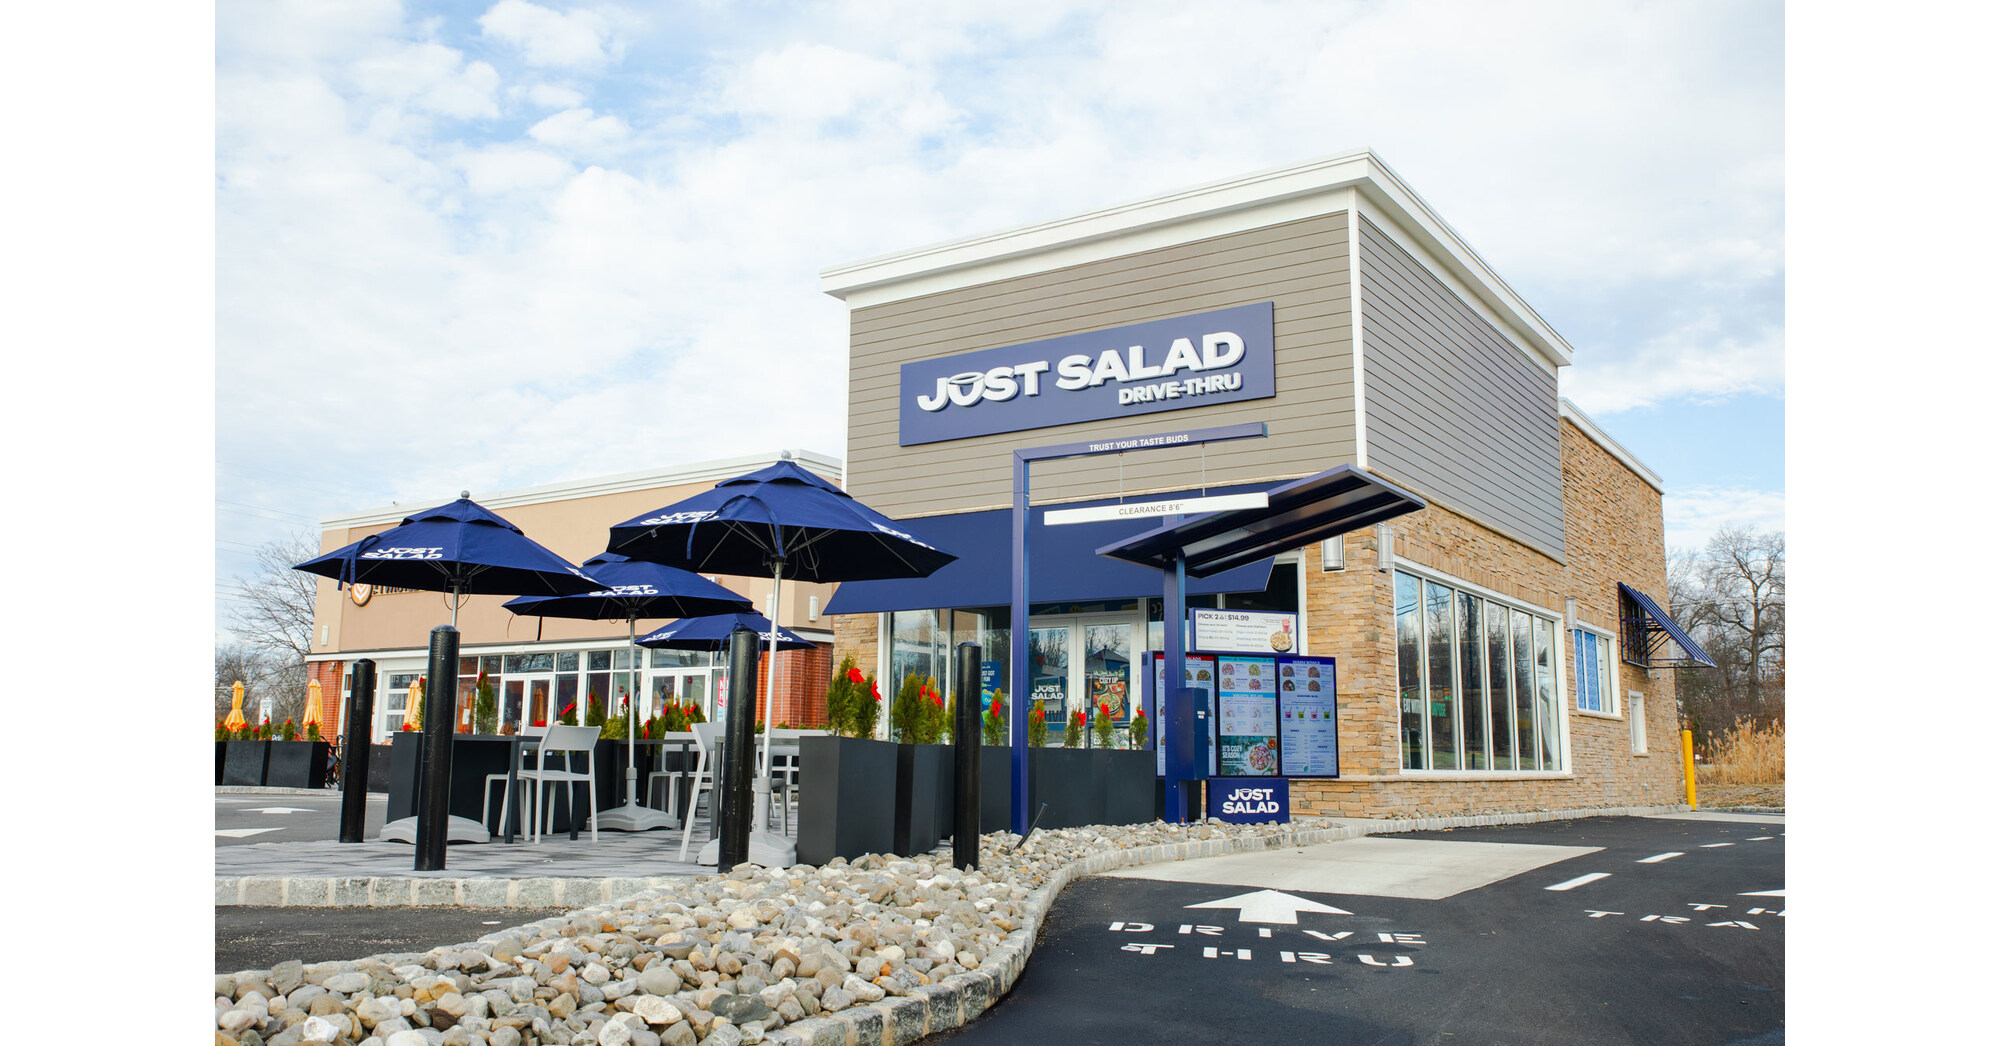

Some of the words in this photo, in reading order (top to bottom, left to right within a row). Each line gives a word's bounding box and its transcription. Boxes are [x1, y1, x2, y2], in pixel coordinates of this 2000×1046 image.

[917, 360, 1049, 411] JUST
[1056, 331, 1245, 390] SALAD
[1118, 372, 1242, 405] DRIVE-THRU
[1089, 442, 1115, 452] TRUST
[1116, 440, 1138, 449] YOUR
[1140, 437, 1165, 446] TASTE
[1166, 434, 1189, 444] BUDS
[1119, 504, 1167, 515] CLEARANCE
[1031, 692, 1065, 700] SALAD
[1034, 685, 1061, 693] JUST
[1228, 788, 1274, 801] JUST
[1222, 801, 1280, 814] SALAD
[1109, 921, 1427, 944] DRIVE
[1122, 942, 1414, 967] THRU
